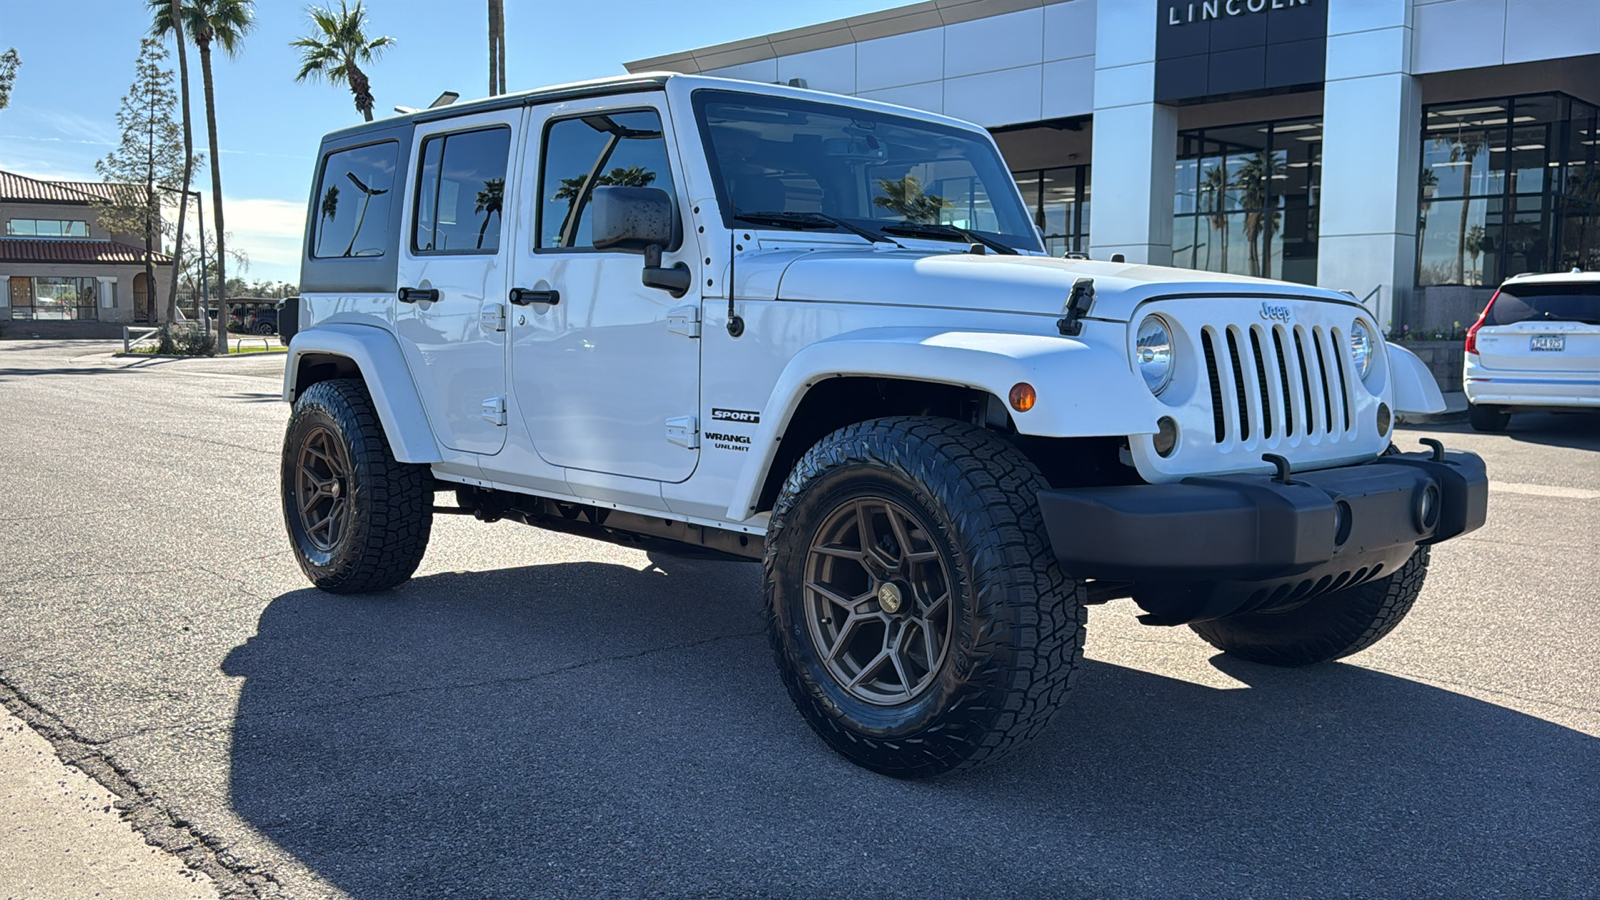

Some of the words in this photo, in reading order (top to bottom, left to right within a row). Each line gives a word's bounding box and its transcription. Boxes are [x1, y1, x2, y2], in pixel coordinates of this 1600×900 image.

[1169, 0, 1307, 25] LINCOL
[1259, 301, 1291, 323] Jeep
[714, 410, 760, 421] SPORT
